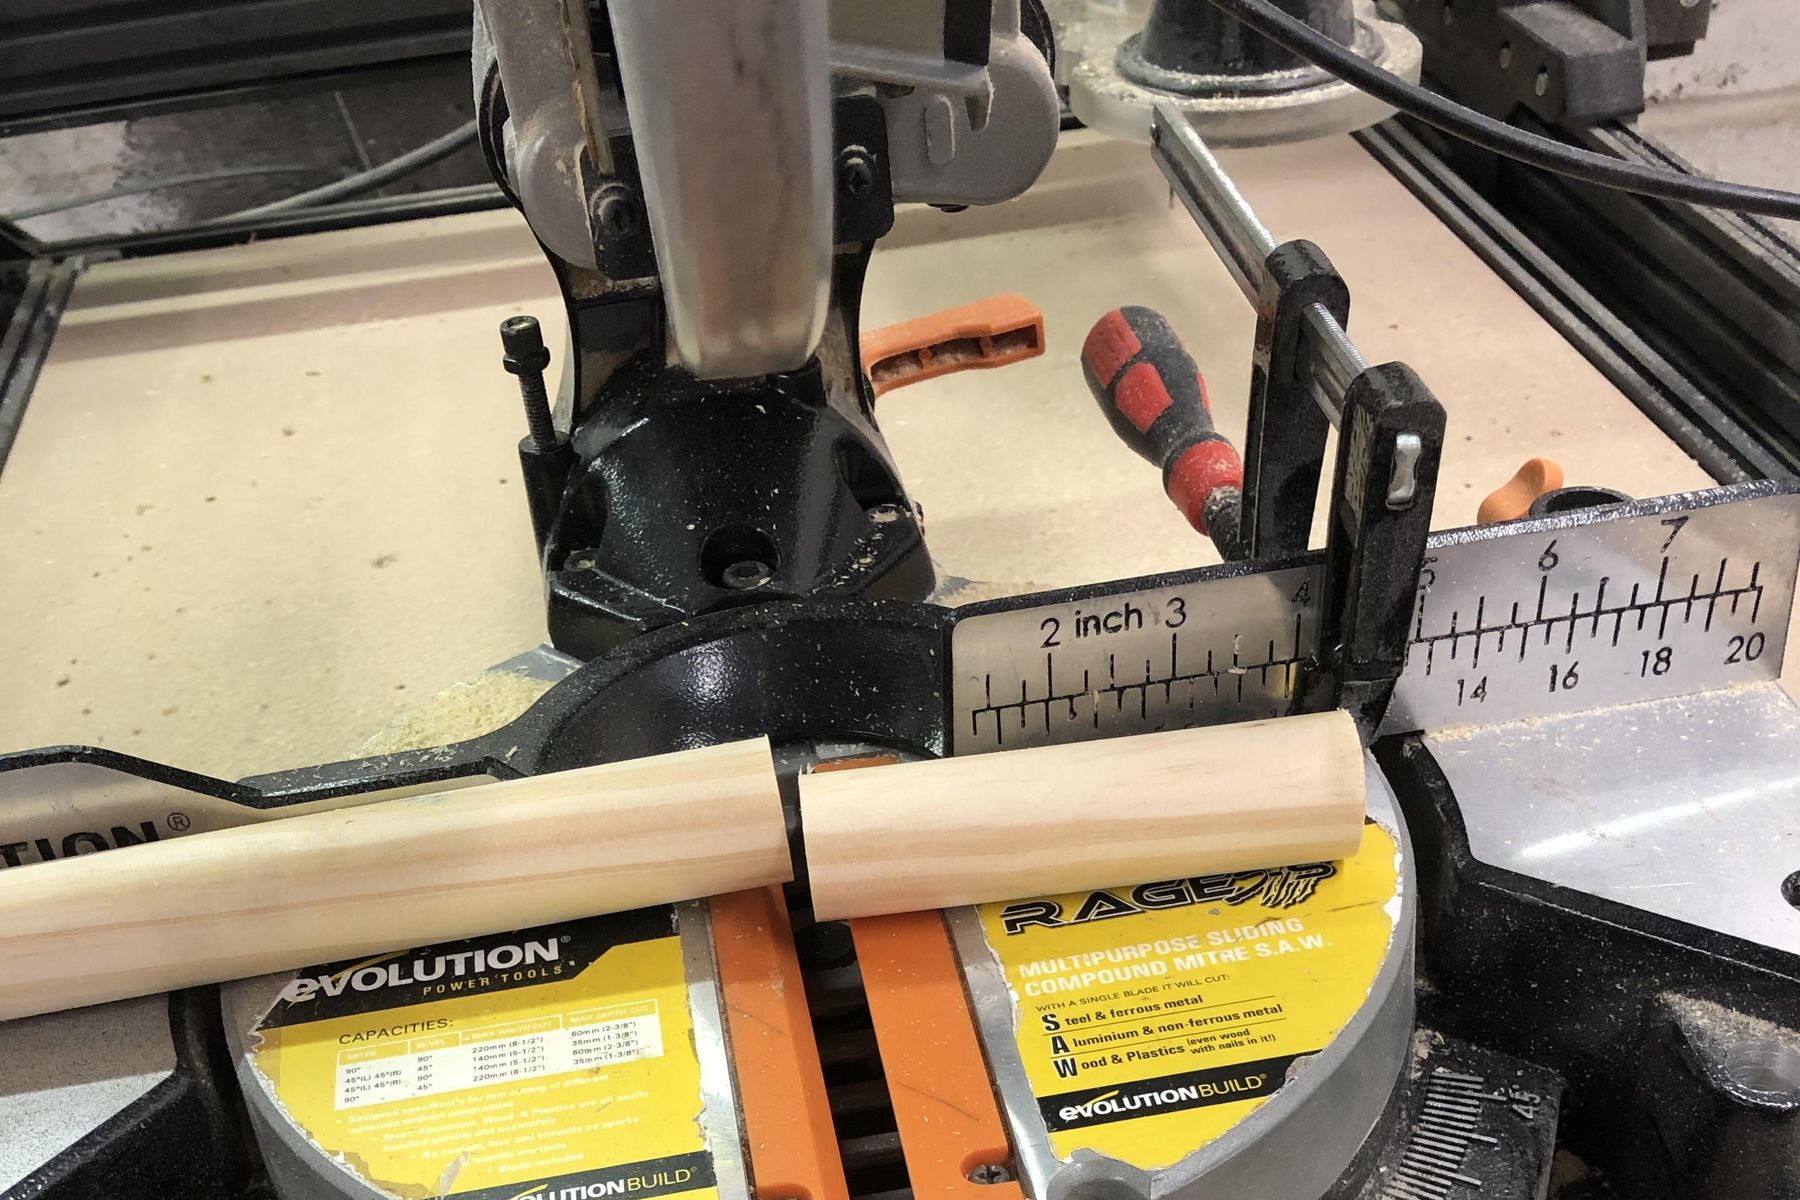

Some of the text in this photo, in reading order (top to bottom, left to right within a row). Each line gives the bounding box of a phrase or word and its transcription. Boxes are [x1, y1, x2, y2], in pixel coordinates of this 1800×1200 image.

[1538, 539, 1559, 571] 6
[1659, 515, 1689, 554] 7
[1040, 617, 1061, 649] 2
[1075, 602, 1143, 640] inch
[1165, 597, 1187, 628] 3
[1456, 631, 1766, 706] 14 16 18 20
[1018, 917, 1304, 979] MULTIPURPOSE SLIDING
[1024, 934, 1333, 998] COMPOUND MITRE S.A.W.
[423, 965, 563, 996] POWER TOOLS
[1036, 1002, 1065, 1012] WITH
[1079, 992, 1120, 1005] SINGLE
[1123, 986, 1159, 998] BLADE
[1162, 983, 1172, 991] IT
[1175, 979, 1202, 989] WILL
[1205, 974, 1230, 984] CUT:
[1095, 1011, 1106, 1021] &
[1110, 1003, 1160, 1018] ferrous
[1164, 994, 1203, 1009] metal
[1142, 1025, 1154, 1036] &
[1158, 1012, 1240, 1033] non-ferrous
[1243, 1003, 1283, 1019] metal
[338, 1018, 454, 1045] CAPACITIES:
[472, 1043, 506, 1054] 220mm
[571, 1028, 600, 1038] 60mm
[1186, 1029, 1250, 1046] (even wood
[1190, 1033, 1276, 1055] with nails in it!)
[473, 1052, 506, 1063] 140mm
[473, 1061, 507, 1072] 140mm
[1111, 1054, 1123, 1065] &
[1126, 1045, 1185, 1062] Plastics
[472, 1071, 507, 1082] 220mm
